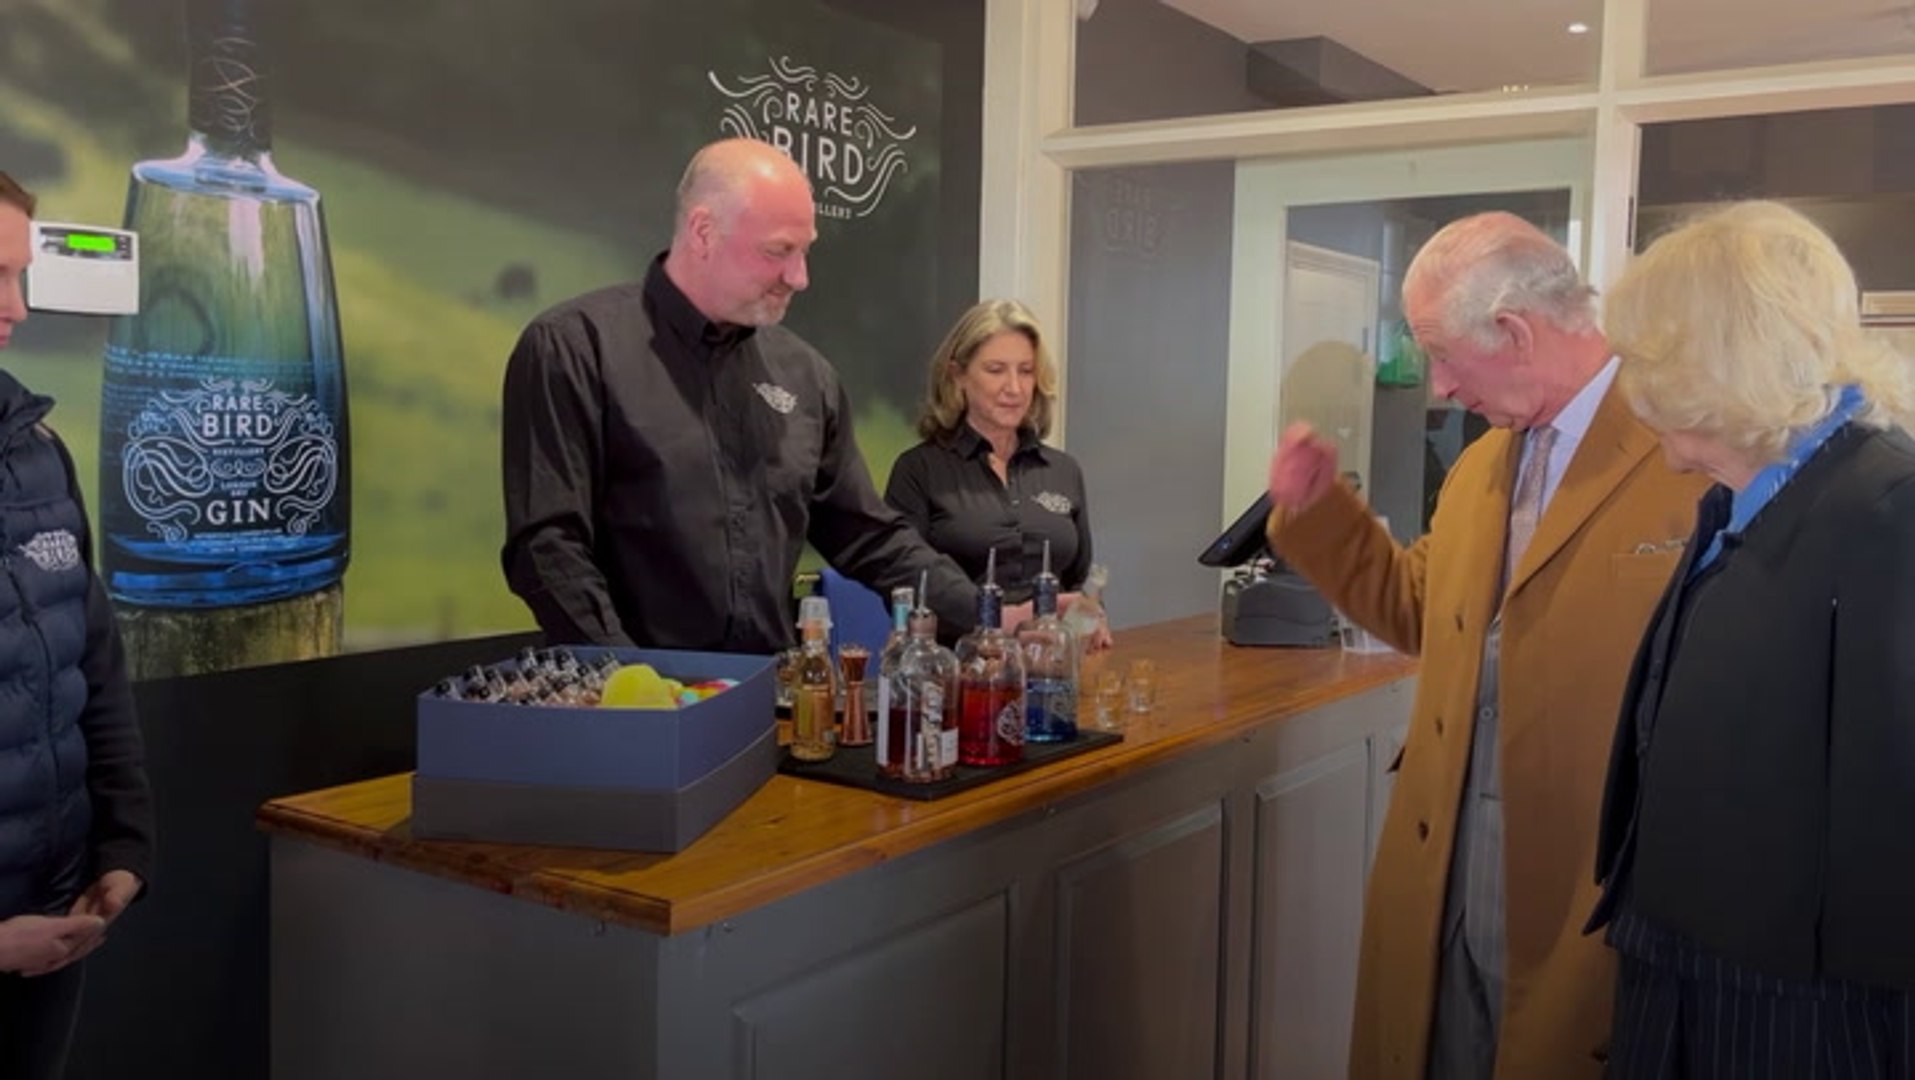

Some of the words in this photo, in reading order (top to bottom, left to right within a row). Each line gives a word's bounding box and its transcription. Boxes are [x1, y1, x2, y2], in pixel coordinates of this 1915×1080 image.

[786, 92, 853, 137] RARE
[212, 394, 263, 412] RARE
[202, 413, 273, 438] BIRD
[206, 498, 271, 525] GIN
